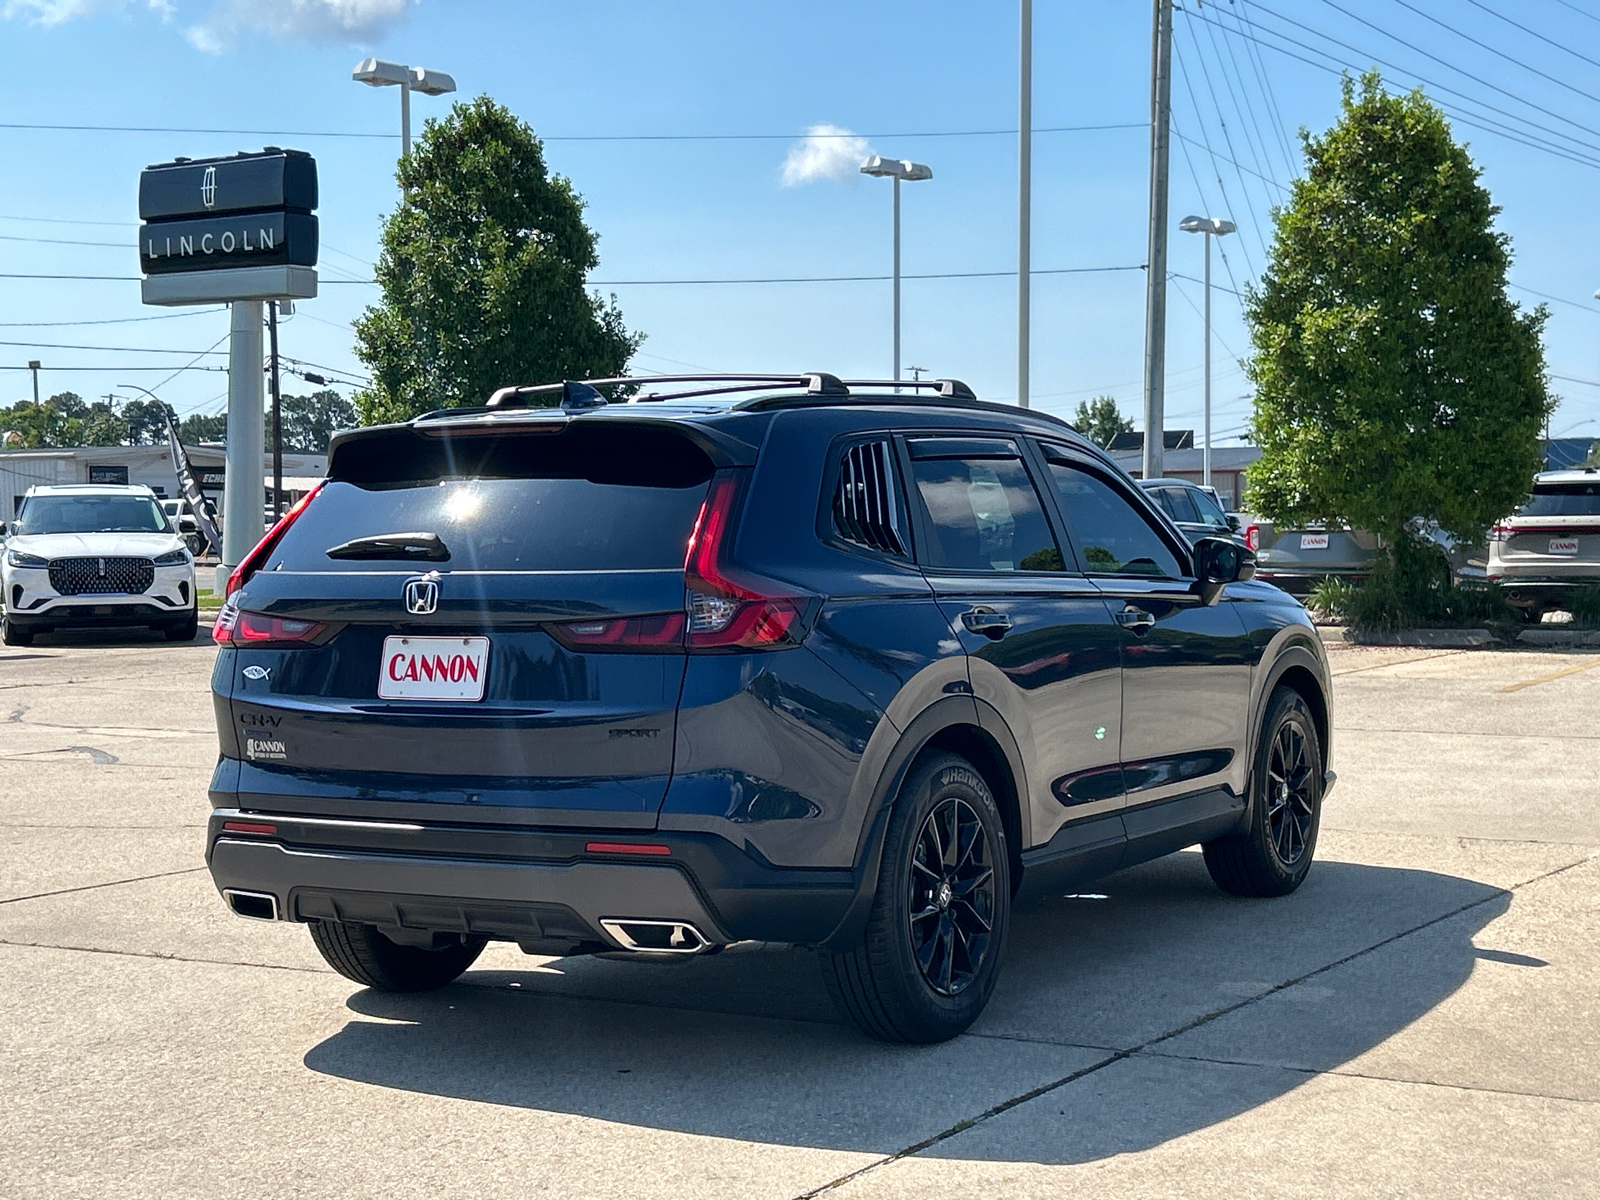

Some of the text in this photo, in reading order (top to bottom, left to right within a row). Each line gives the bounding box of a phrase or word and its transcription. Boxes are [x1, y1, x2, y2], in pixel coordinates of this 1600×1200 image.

[149, 228, 274, 259] LINCOLN
[388, 653, 481, 683] CANNON
[241, 713, 283, 728] CR-V
[608, 728, 660, 738] SPORT
[254, 740, 286, 753] CANNON
